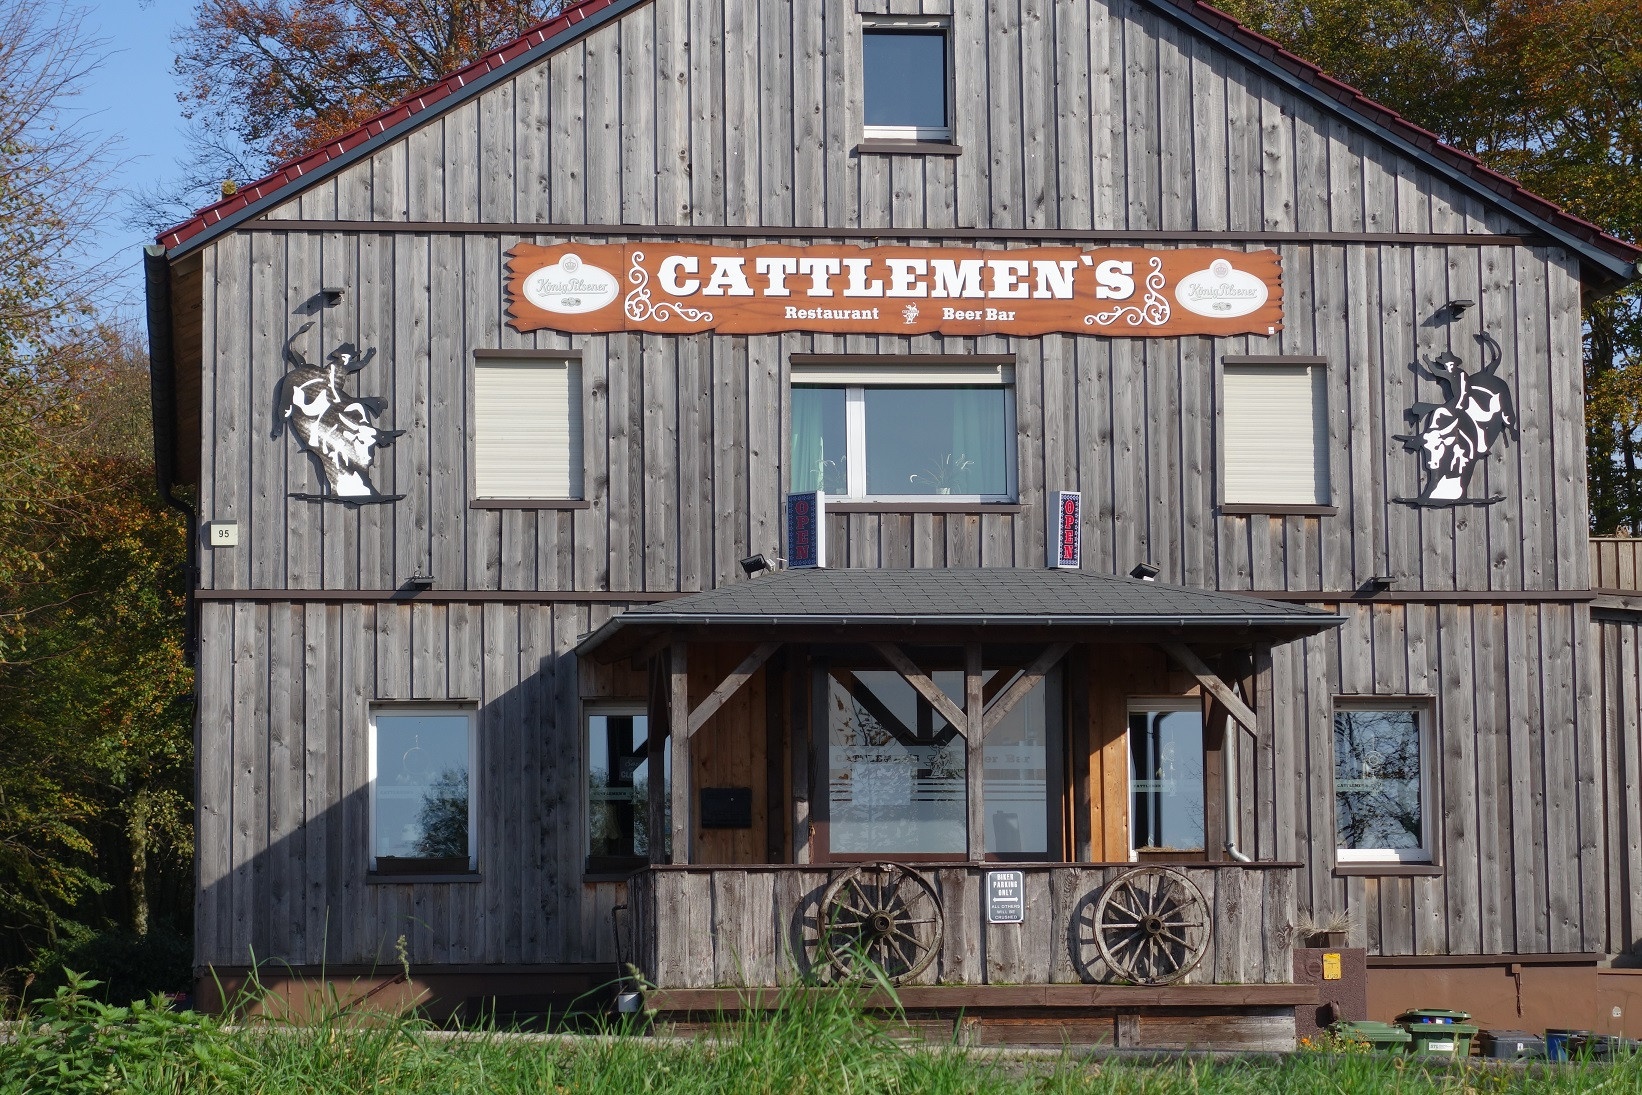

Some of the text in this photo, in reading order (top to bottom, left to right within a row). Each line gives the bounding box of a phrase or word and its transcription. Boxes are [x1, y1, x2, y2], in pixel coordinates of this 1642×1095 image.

[537, 278, 608, 296] König Pilsener
[785, 306, 879, 319] Restaurant
[942, 307, 1015, 320] Beer Bar
[218, 529, 230, 538] 95
[796, 501, 809, 559] OPEN
[1064, 500, 1075, 559] OPEN
